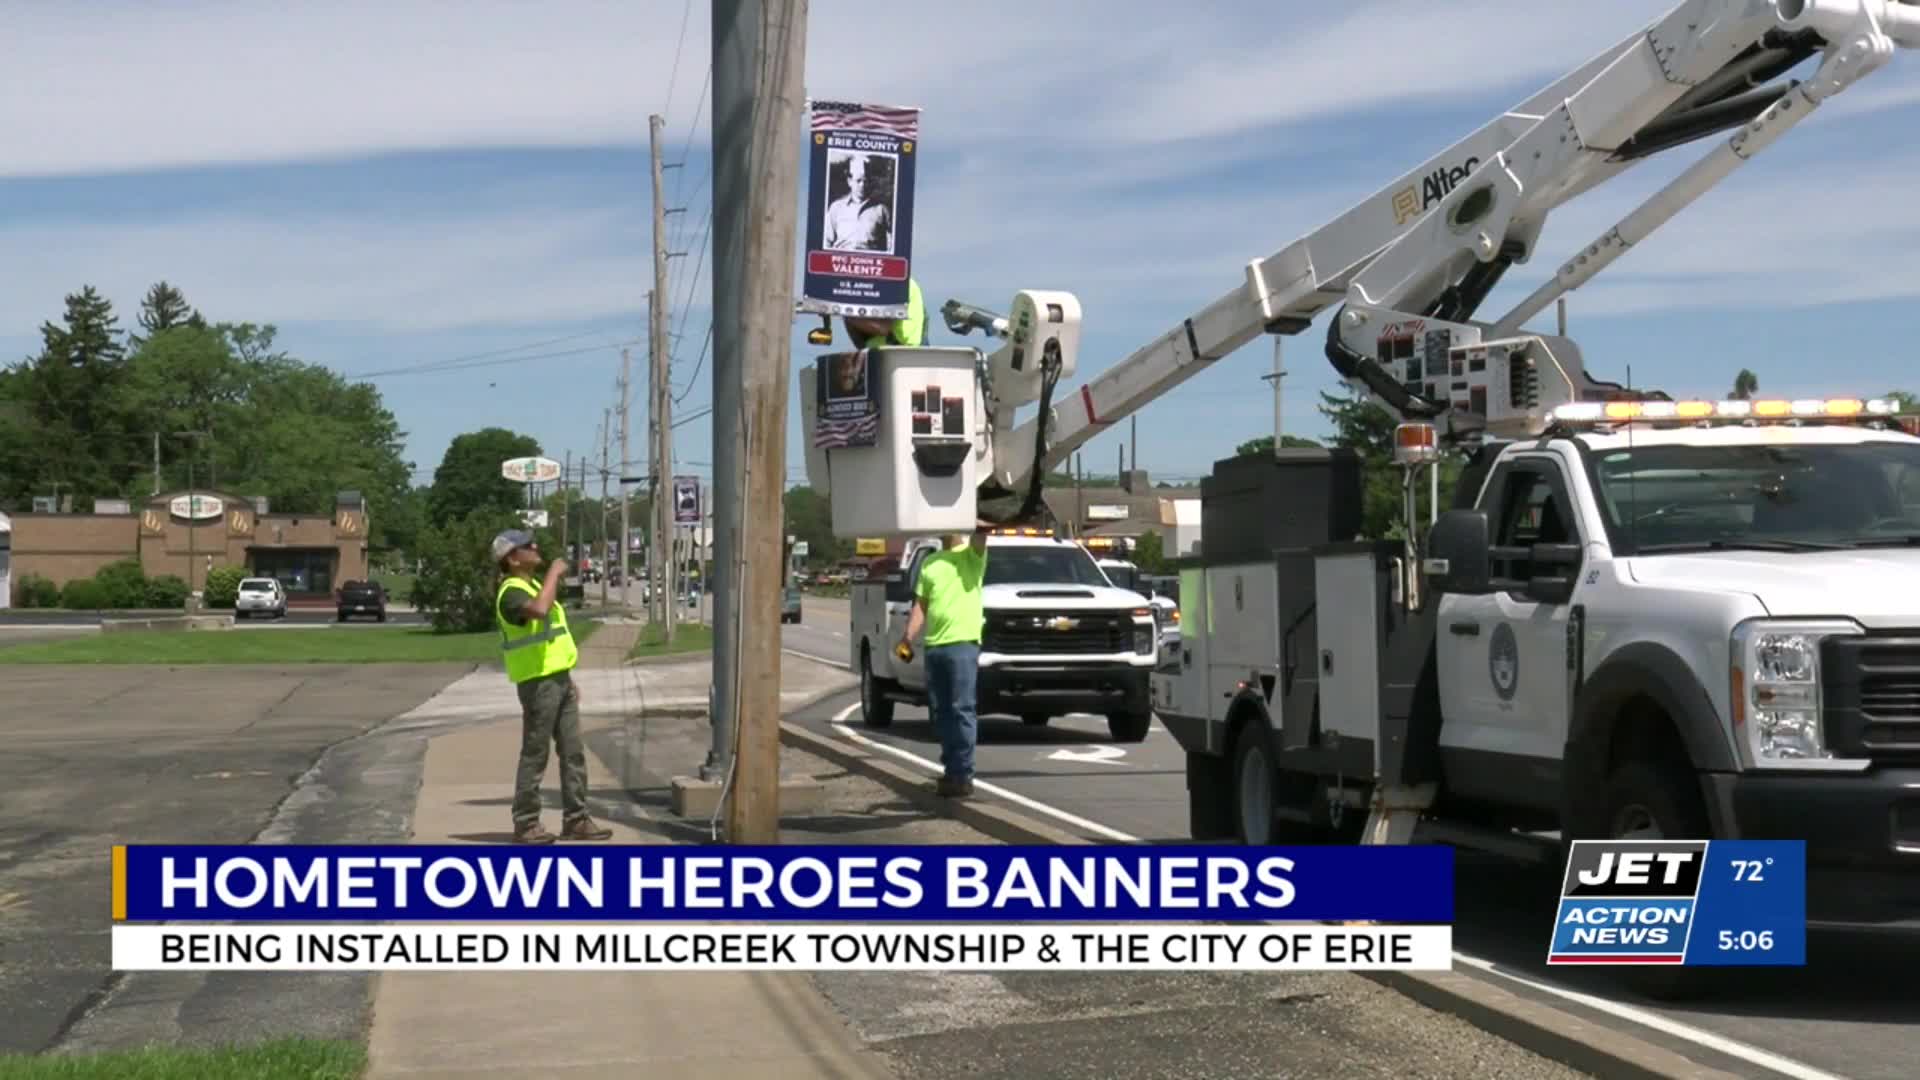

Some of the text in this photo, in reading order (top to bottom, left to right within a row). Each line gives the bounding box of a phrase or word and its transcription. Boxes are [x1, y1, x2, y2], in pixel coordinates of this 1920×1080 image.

[827, 137, 899, 152] ERIE COUNTY
[1423, 157, 1479, 211] Altec
[832, 264, 883, 275] VALENTZ
